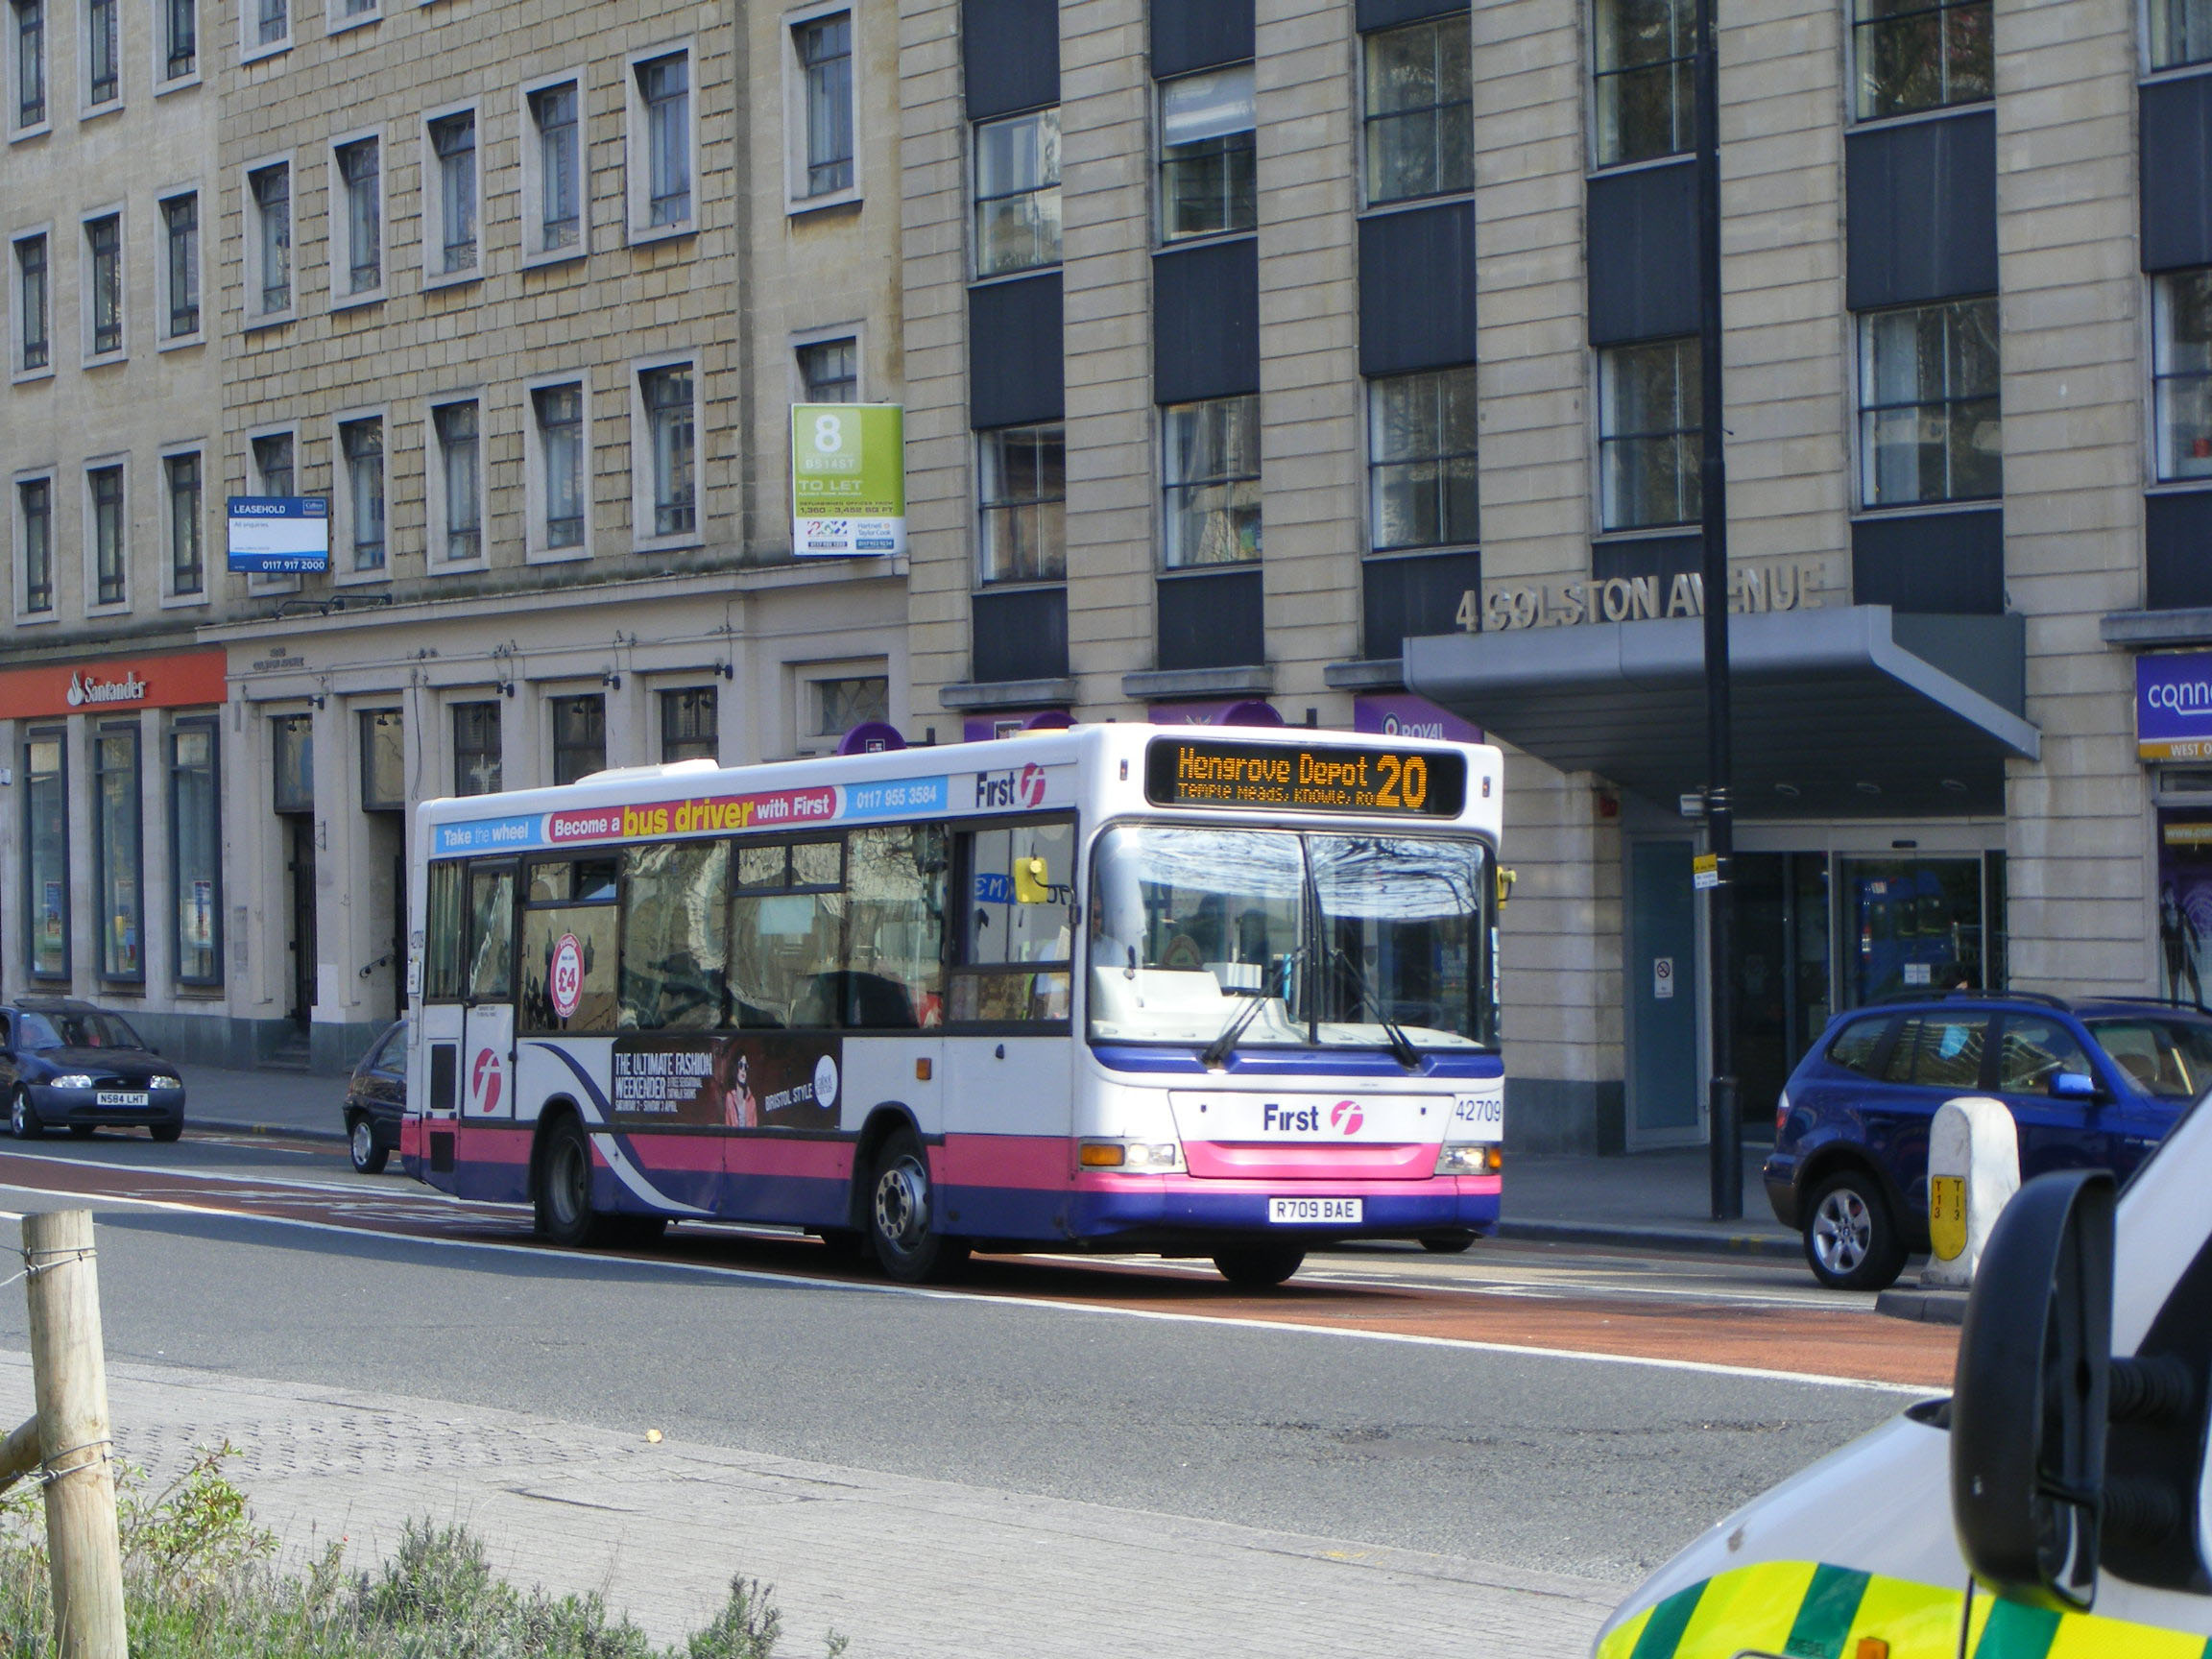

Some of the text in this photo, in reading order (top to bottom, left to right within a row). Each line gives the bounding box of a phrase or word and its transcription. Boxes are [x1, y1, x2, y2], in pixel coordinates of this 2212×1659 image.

[814, 413, 843, 454] 8
[798, 479, 862, 493] TO LET
[233, 505, 286, 515] LEASEHOLD
[262, 561, 325, 570] 0117 917 2000
[1455, 589, 1479, 634] 4
[1488, 574, 1661, 633] COLSTON
[84, 671, 147, 704] Santander
[2148, 681, 2212, 715] conn
[2171, 743, 2200, 757] WEST
[975, 771, 1016, 808] First
[1178, 746, 1428, 808] Hengrove Depot 20
[855, 785, 938, 809] 0117 955 3584
[554, 794, 830, 838] Become a bus driver with First
[444, 821, 529, 847] Take the wheel
[558, 966, 576, 993] £4
[615, 1051, 712, 1076] THE ULTIMATE FASHION
[101, 1094, 145, 1104] N584 LHT
[615, 1076, 666, 1099] WEEKENDER
[765, 1083, 813, 1112] BRISTOL STYLE
[1262, 1099, 1502, 1131] First 42709
[1276, 1201, 1356, 1218] R709 BAE
